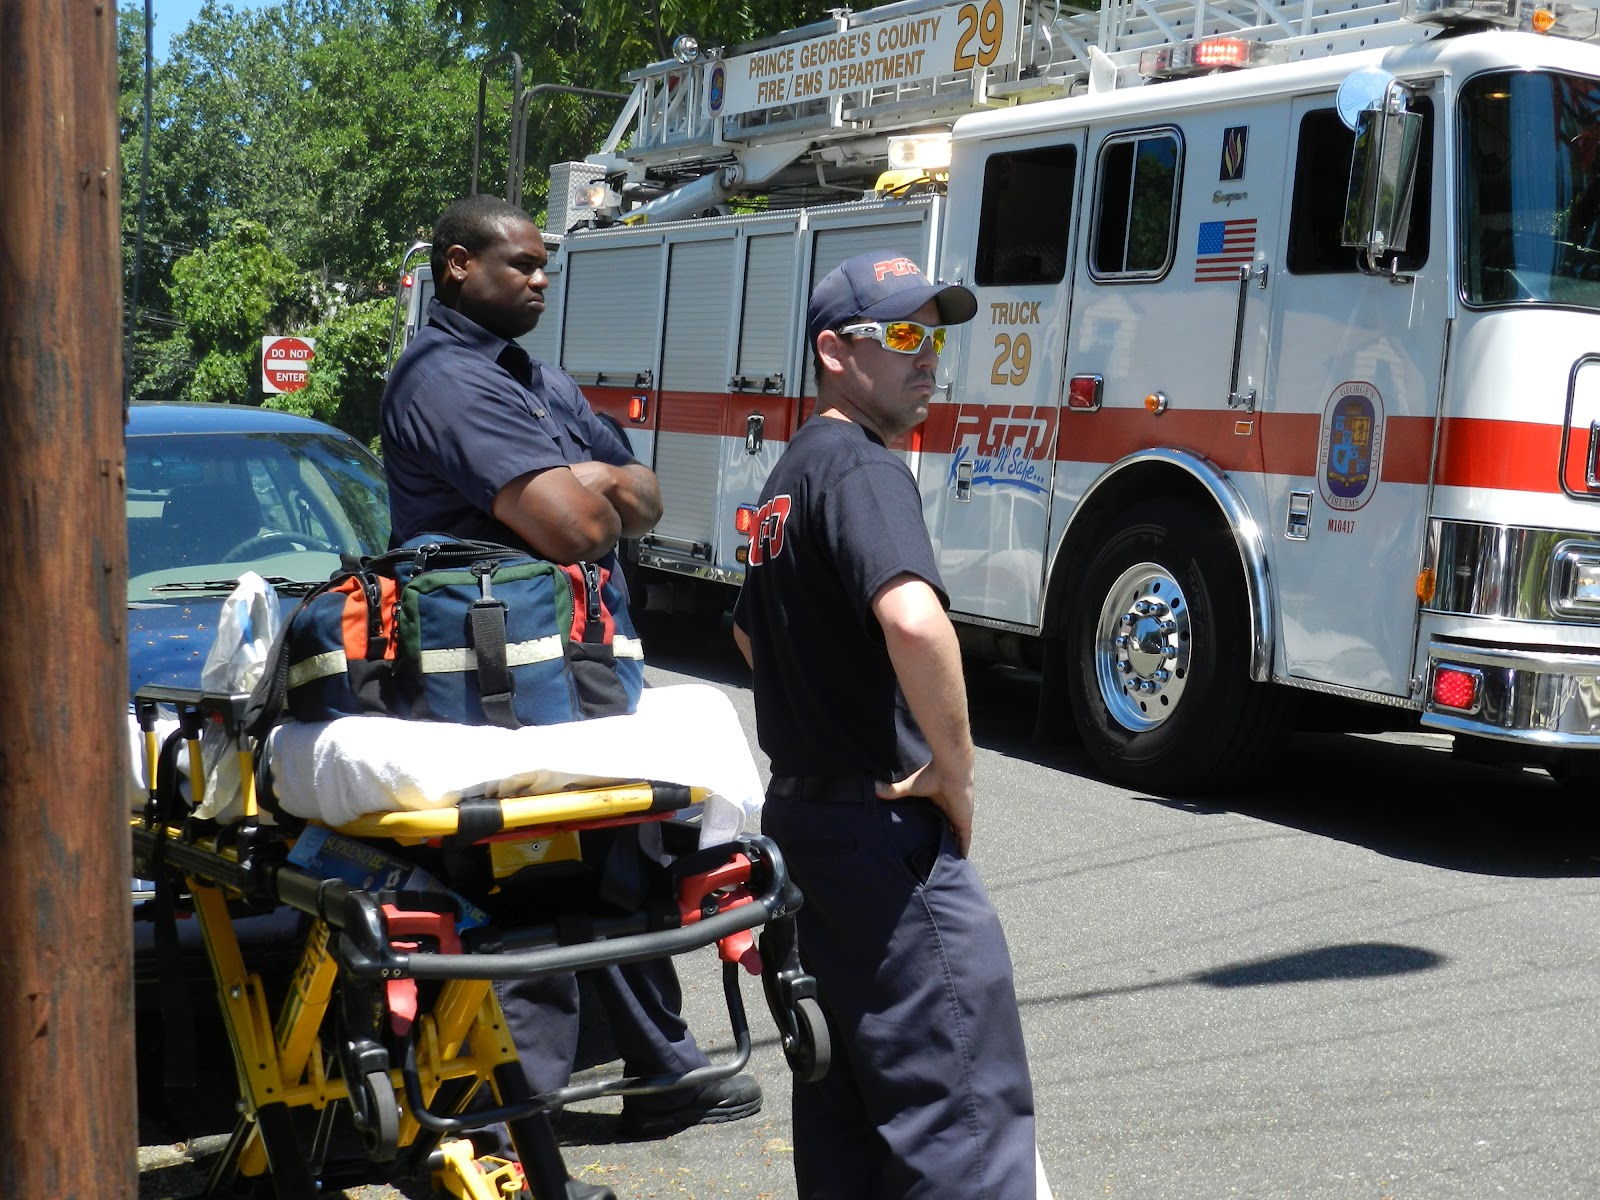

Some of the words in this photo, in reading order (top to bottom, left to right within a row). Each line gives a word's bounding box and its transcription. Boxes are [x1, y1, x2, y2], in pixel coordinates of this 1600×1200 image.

[748, 48, 795, 80] PRINCE
[800, 31, 871, 69] GEORGE'S
[877, 15, 942, 53] COUNTY
[953, 0, 1004, 72] 29
[757, 69, 823, 105] FIRE/EMS
[828, 49, 926, 91] DEPARTMENT
[990, 301, 1042, 325] TRUCK
[271, 348, 286, 358] DO
[289, 348, 309, 358] NOT
[990, 332, 1032, 387] 29
[276, 372, 305, 382] ENTER
[1340, 384, 1376, 400] GEORGE'S
[951, 404, 1058, 460] PGFD
[1321, 424, 1331, 465] PRINCE
[1327, 518, 1355, 534] M10417
